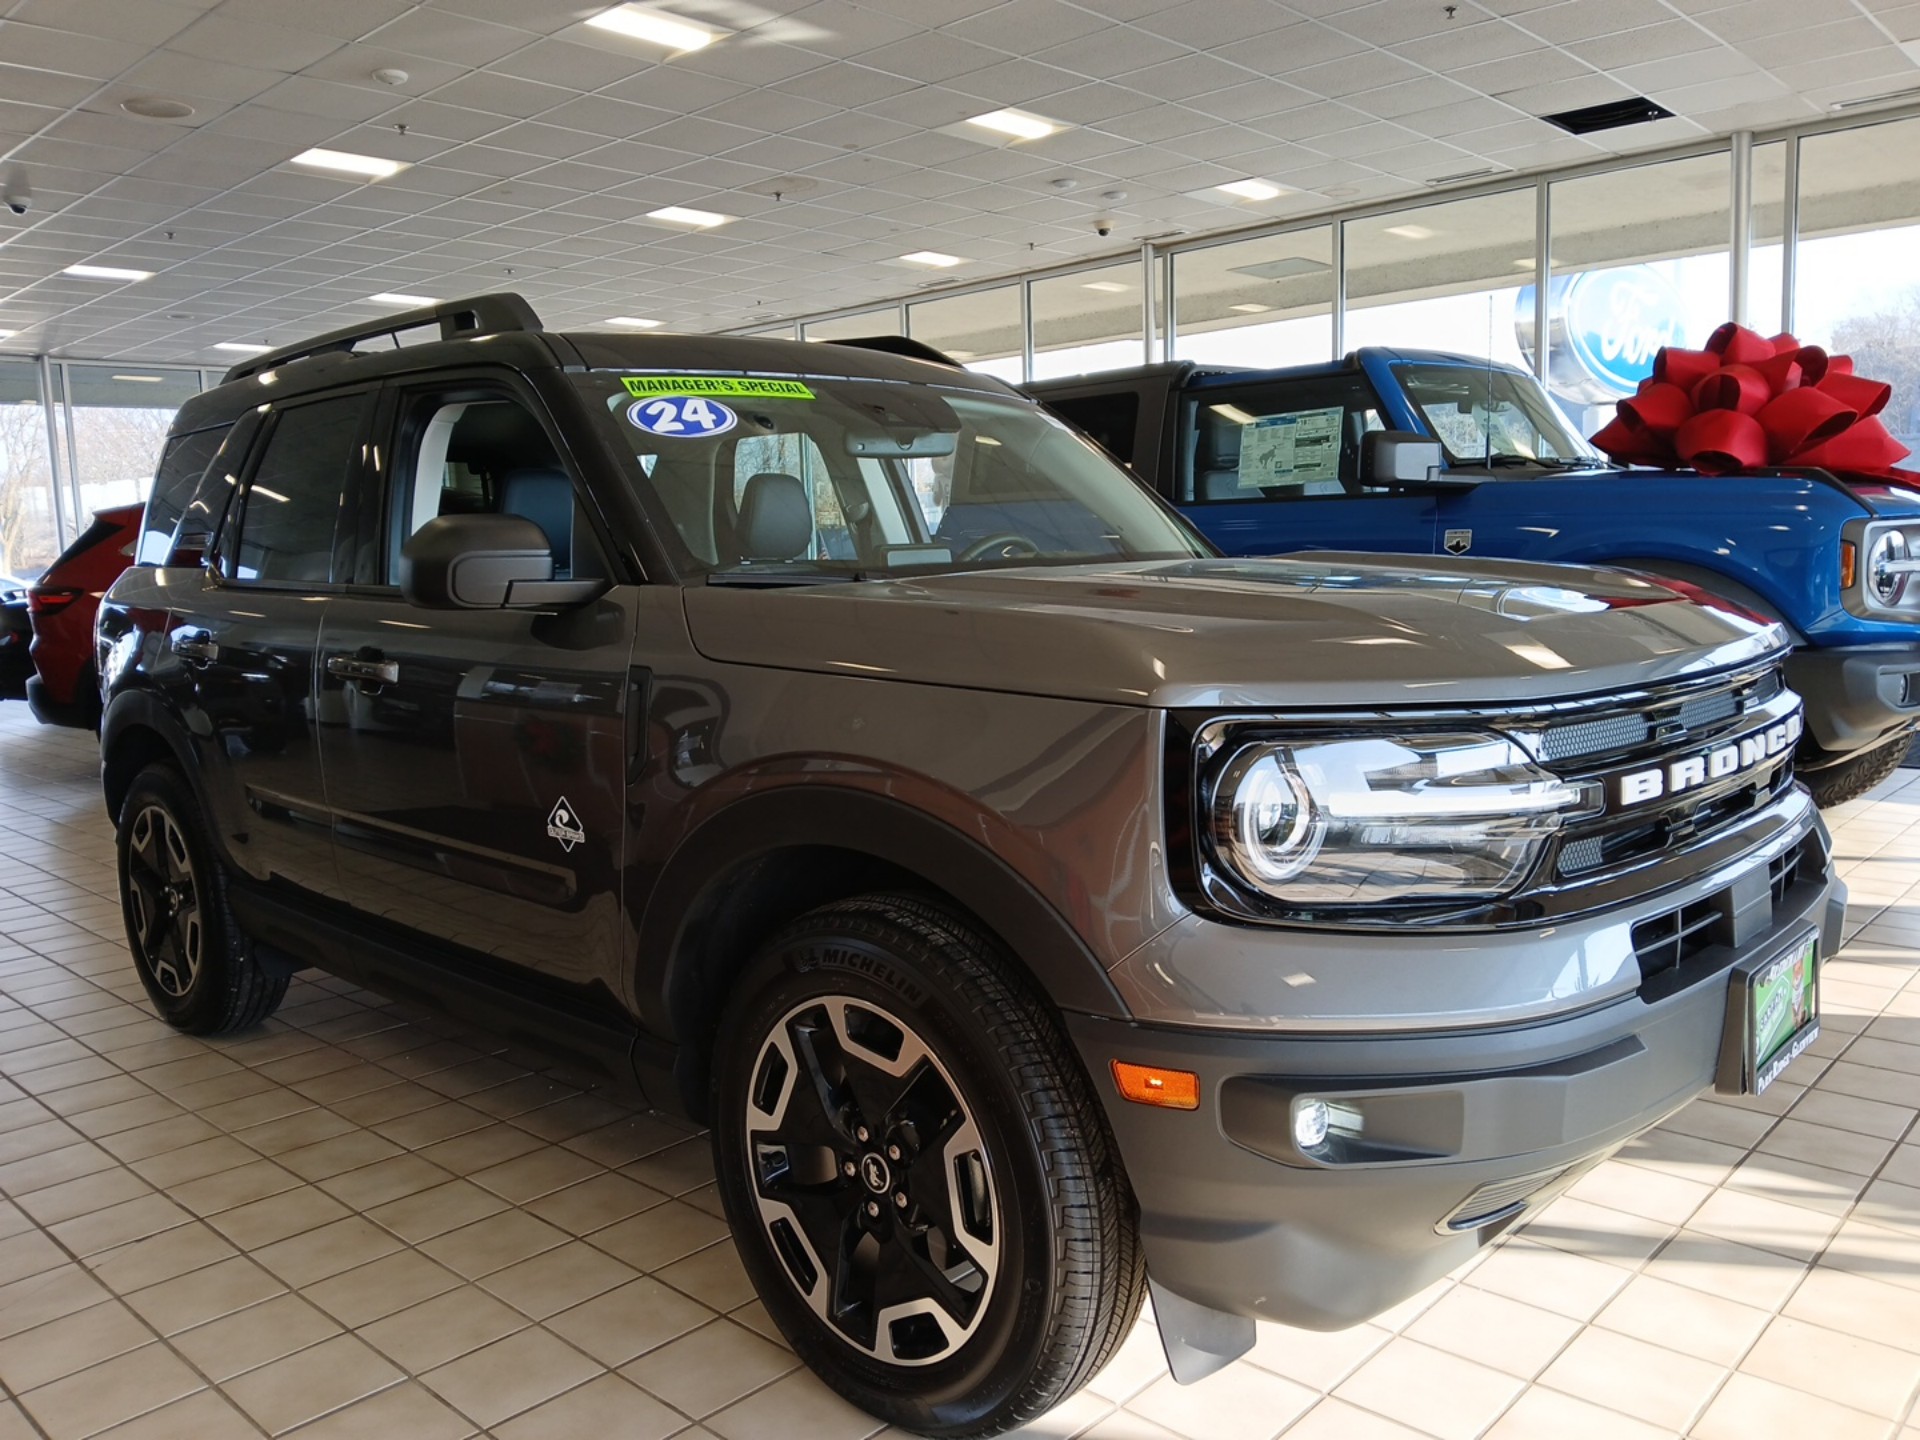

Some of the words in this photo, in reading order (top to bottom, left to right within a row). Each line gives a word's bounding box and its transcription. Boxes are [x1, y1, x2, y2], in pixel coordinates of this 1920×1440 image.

[1602, 280, 1675, 365] Ford
[628, 379, 734, 393] MANAGER'S
[739, 381, 805, 394] SPECIAL
[646, 399, 717, 433] 24
[1620, 714, 1803, 806] BRONCO
[822, 948, 923, 1003] MICHELIN
